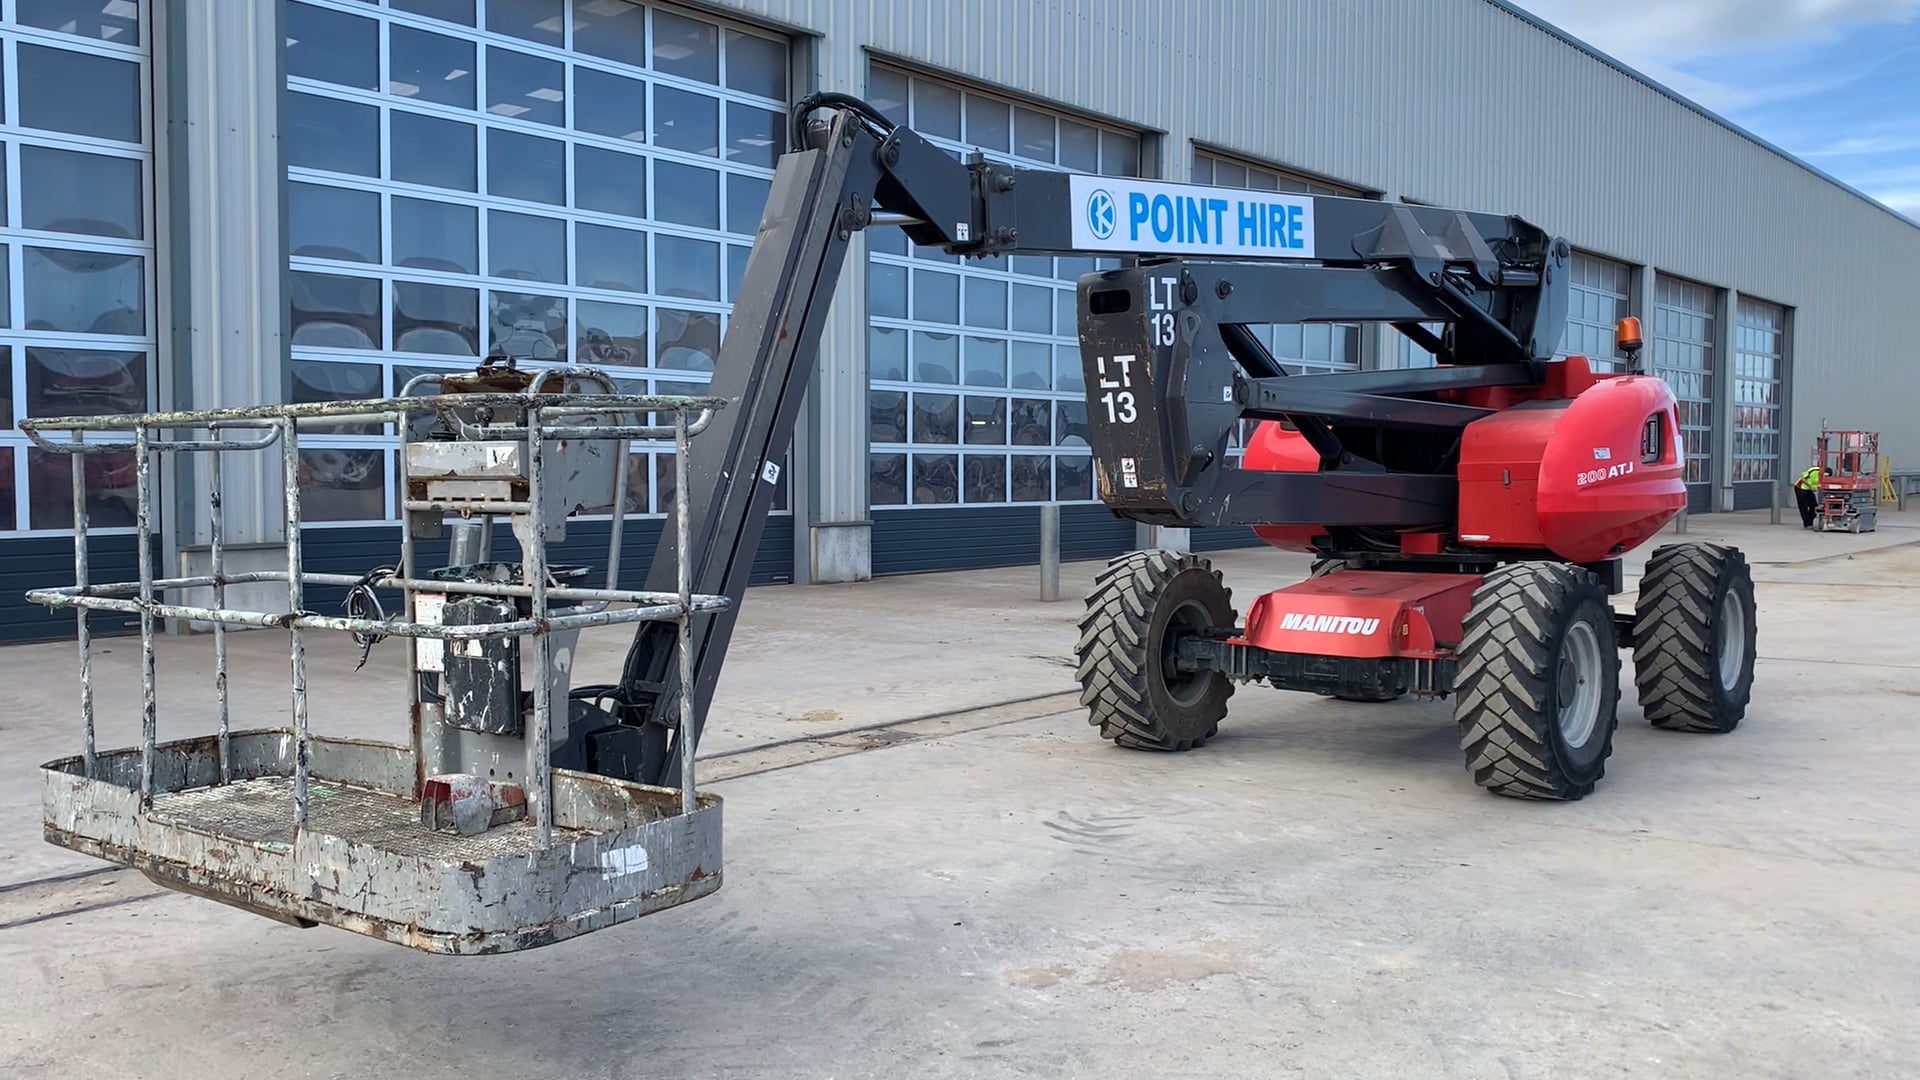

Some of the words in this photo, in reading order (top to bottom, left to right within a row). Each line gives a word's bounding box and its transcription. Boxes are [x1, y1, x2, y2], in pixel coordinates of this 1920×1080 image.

[1129, 192, 1228, 245] POINT
[1238, 201, 1304, 249] HIRE
[1150, 277, 1177, 310] LT
[1151, 312, 1176, 346] 13
[1097, 354, 1136, 389] LT
[1101, 391, 1138, 424] 13
[1577, 468, 1607, 486] 200
[1607, 461, 1634, 479] ATJ
[1280, 613, 1380, 636] MANITOU
